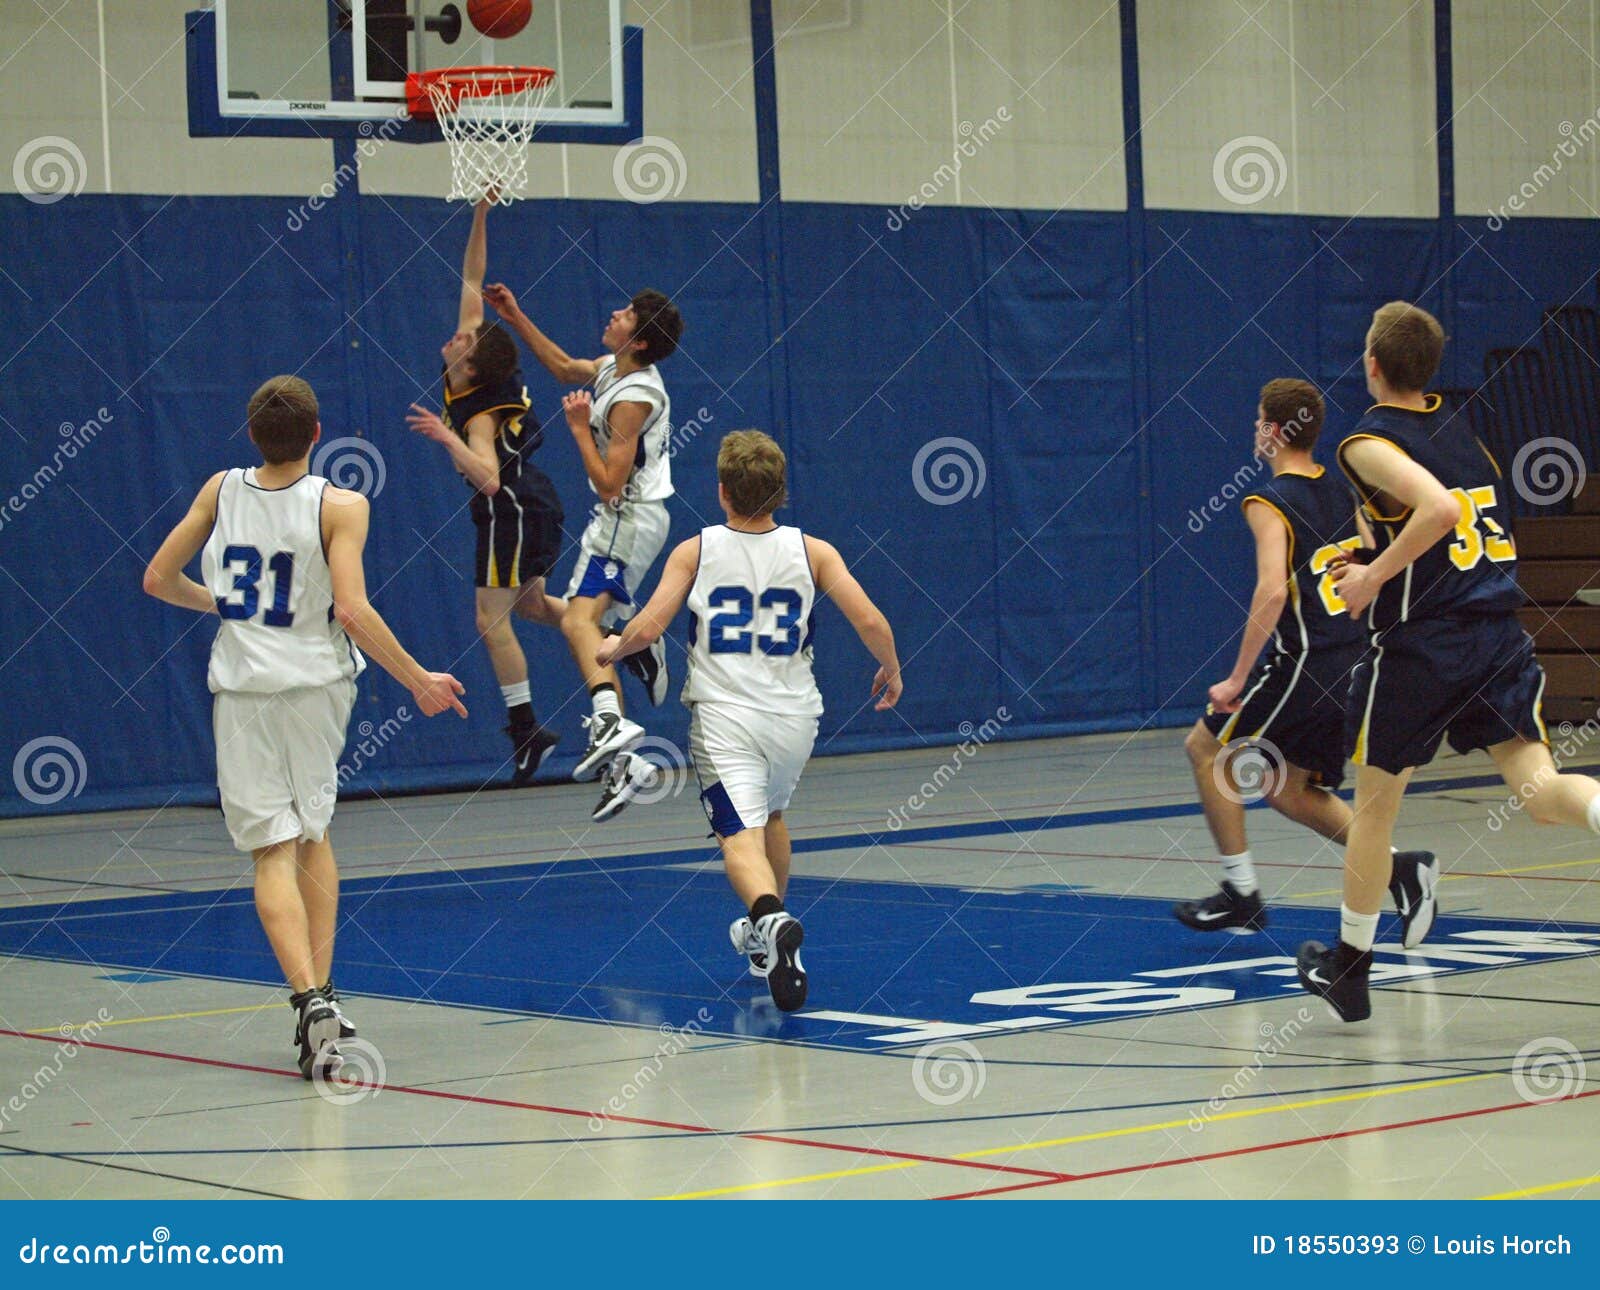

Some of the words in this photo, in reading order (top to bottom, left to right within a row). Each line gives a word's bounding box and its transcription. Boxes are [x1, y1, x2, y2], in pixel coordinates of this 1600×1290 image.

[1446, 485, 1517, 571] 35
[216, 545, 295, 627] 31
[708, 585, 803, 656] 23
